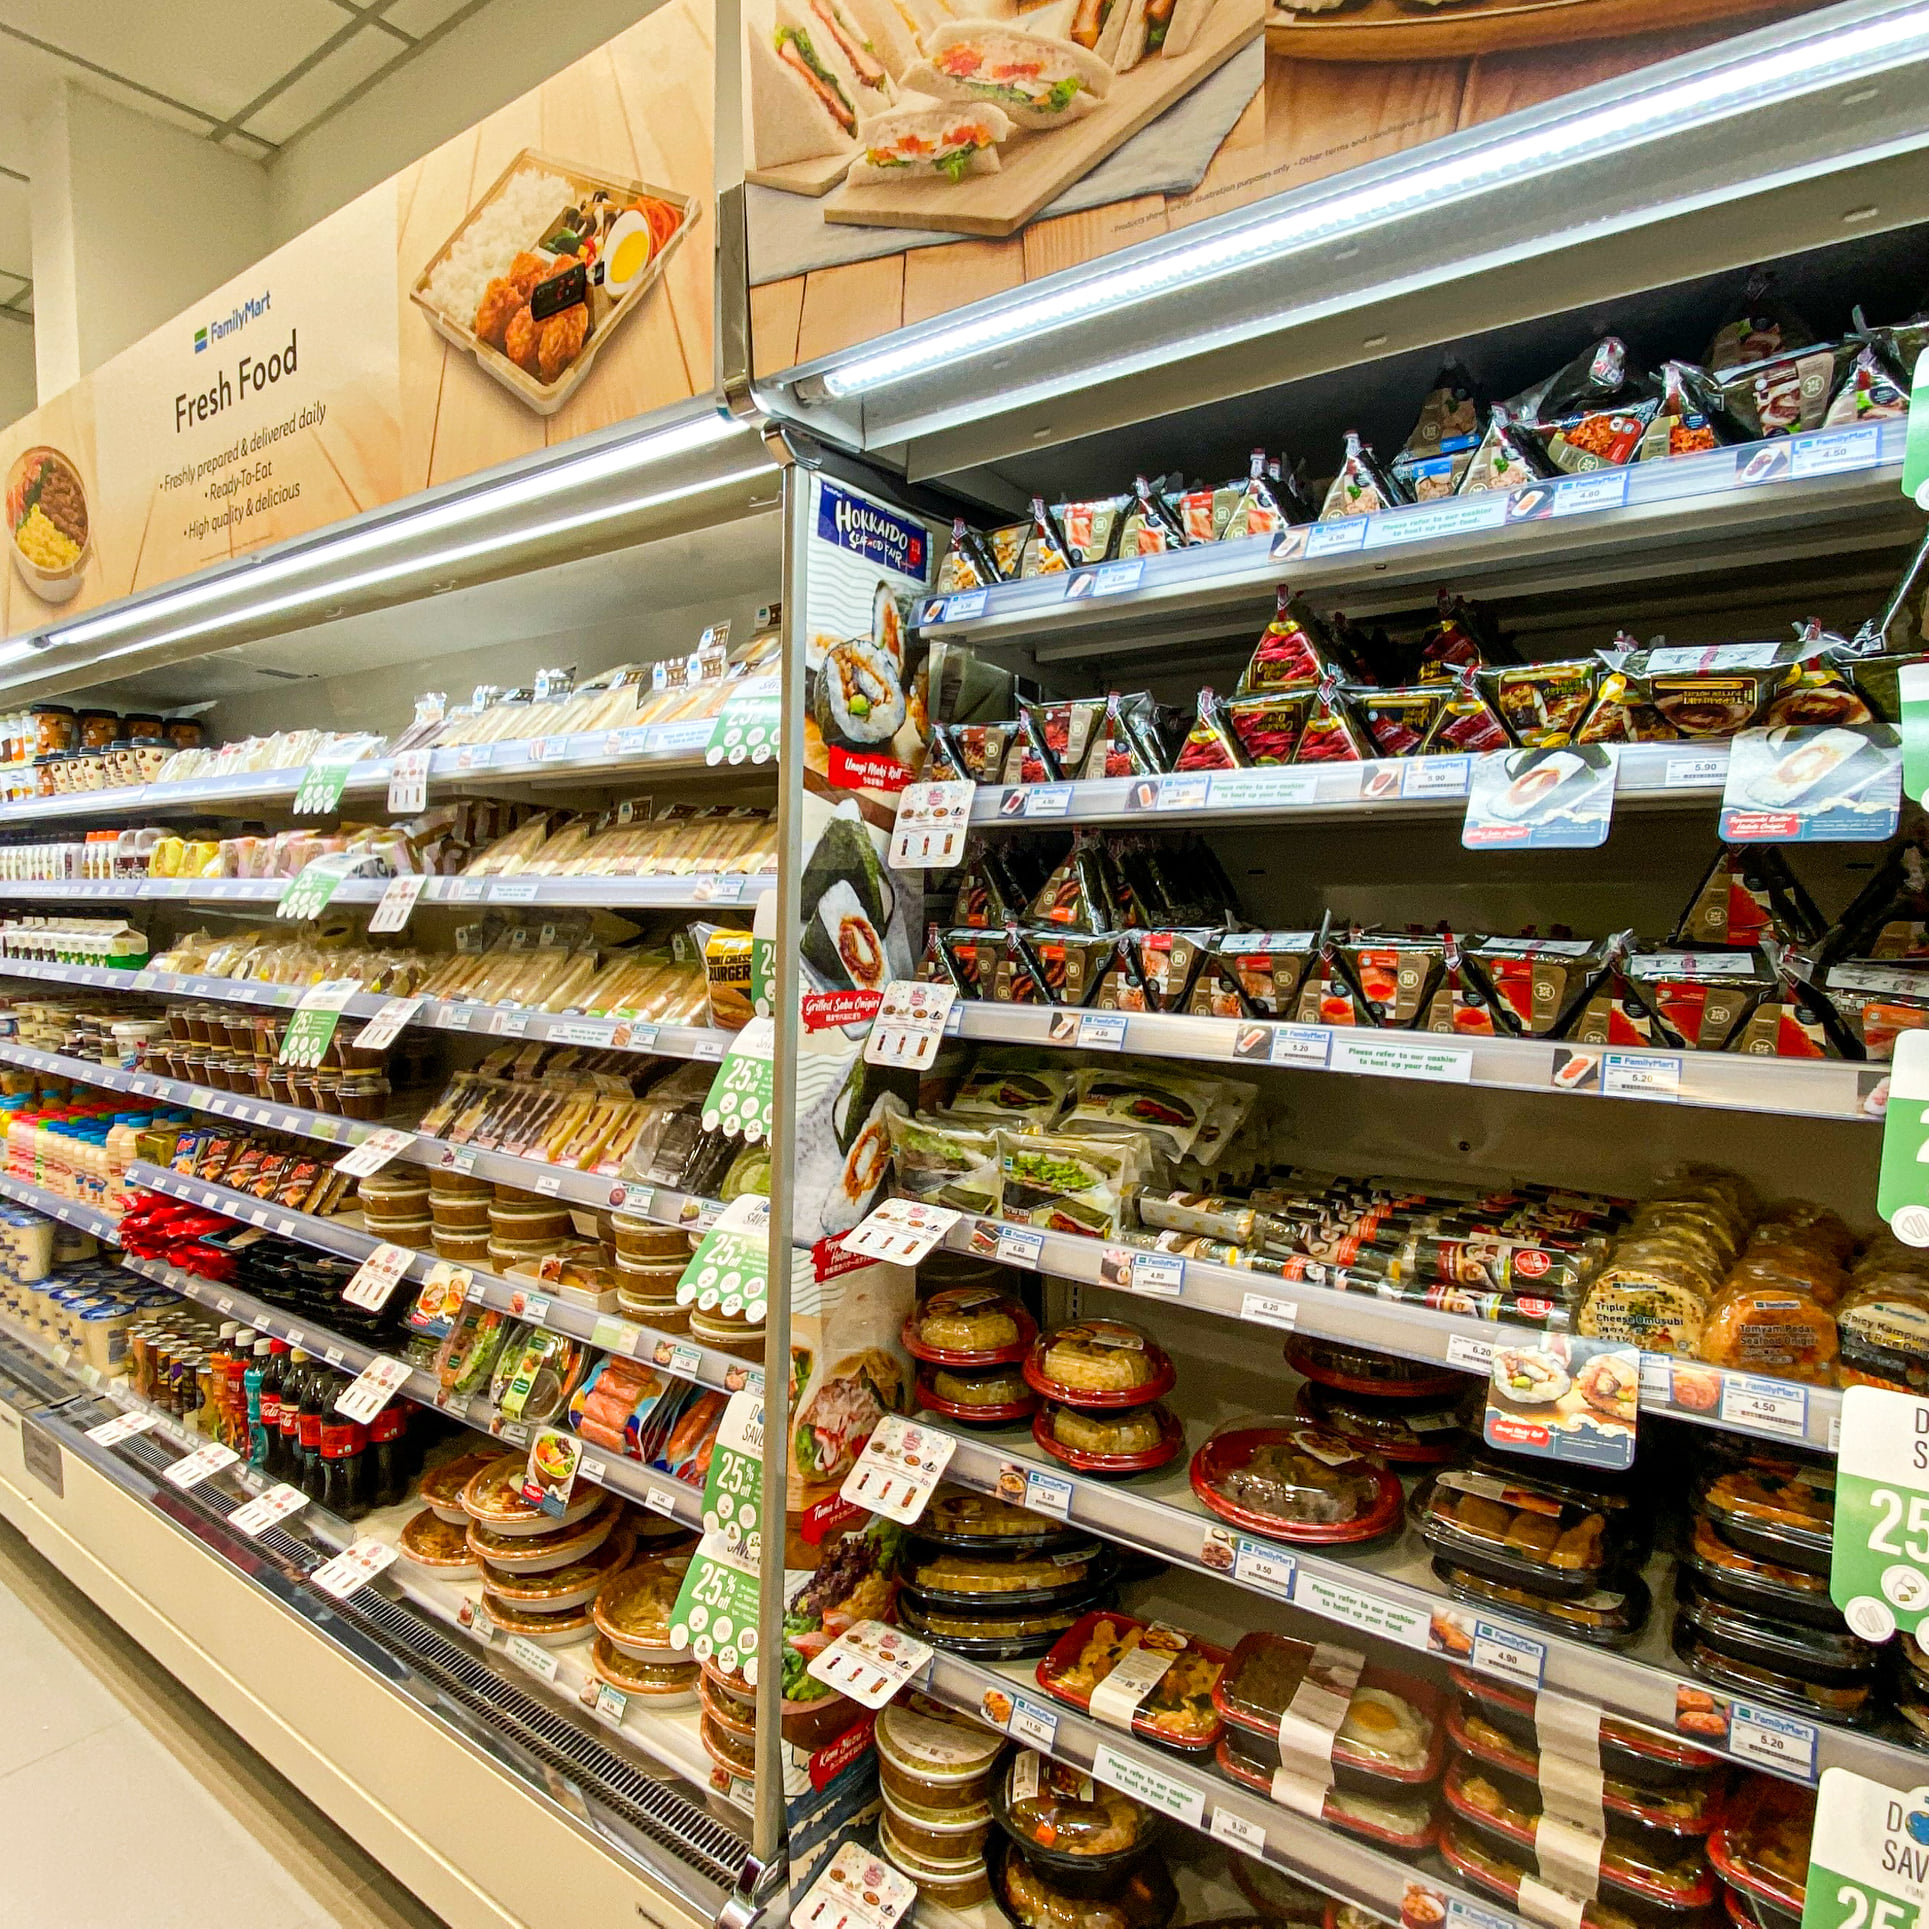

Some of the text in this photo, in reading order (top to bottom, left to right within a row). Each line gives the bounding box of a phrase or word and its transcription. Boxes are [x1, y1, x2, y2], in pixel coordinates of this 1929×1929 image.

[211, 290, 271, 344] FamilyMart
[175, 328, 298, 433] Fresh Food
[164, 400, 326, 491] Freshly prepared & delivered daily
[209, 459, 273, 501] Ready-To-Eat
[188, 480, 301, 543] High quality & delicious
[835, 500, 909, 551] HOKKAIDO
[844, 757, 868, 776] Unagi
[708, 964, 752, 982] BURGER
[805, 998, 833, 1016] Grilled
[854, 996, 881, 1012] Onigiri
[1348, 1047, 1373, 1057] Please
[1376, 1049, 1396, 1059] refer
[1624, 1057, 1675, 1069] FamilyMart
[1632, 1074, 1653, 1083] 5.20
[1262, 1302, 1279, 1312] 6.20
[1595, 1301, 1626, 1312] Triple
[1596, 1313, 1684, 1326] Cheese Omusubi
[1740, 1324, 1782, 1336] Tomyam
[1877, 1322, 1929, 1346] Kampun
[1471, 1345, 1492, 1357] 6.20
[1744, 1380, 1801, 1399] FamilyMart
[1751, 1401, 1776, 1413] 4.50
[1253, 1547, 1294, 1567] FamilyMart
[1255, 1562, 1273, 1576] 9.50
[1312, 1583, 1336, 1599] Please
[1338, 1592, 1358, 1606] refer
[1387, 1609, 1417, 1627] cashier
[1333, 1601, 1350, 1615] heat
[1364, 1613, 1383, 1626] your
[1494, 1630, 1541, 1656] FamilyMart
[1498, 1650, 1518, 1666] 4.90
[1754, 1713, 1810, 1739] FamilyMart
[1761, 1734, 1784, 1750] 5.20
[1882, 1839, 1929, 1884] SAV
